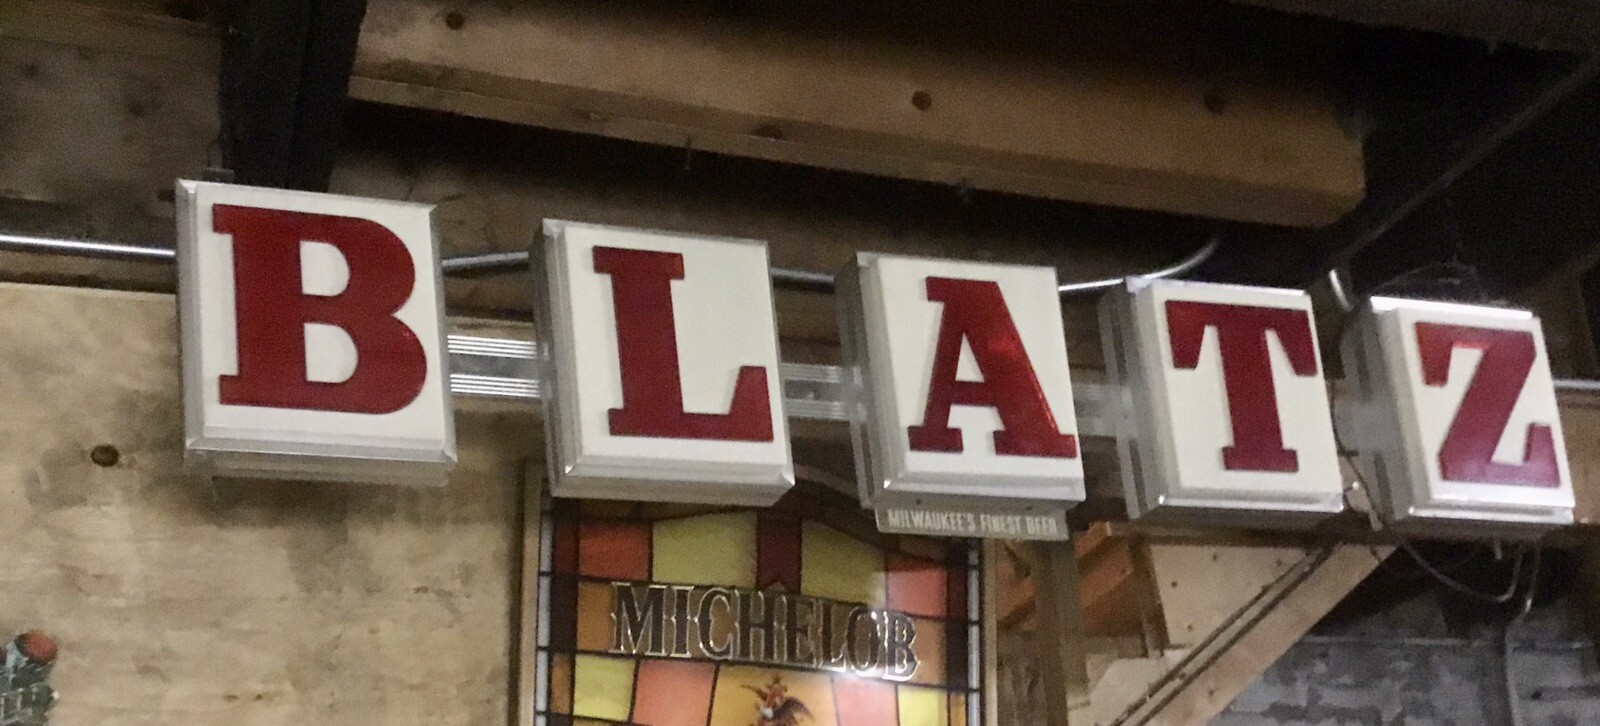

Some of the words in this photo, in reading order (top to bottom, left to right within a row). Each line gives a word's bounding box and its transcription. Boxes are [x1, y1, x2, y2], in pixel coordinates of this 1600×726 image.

[212, 203, 1560, 487] BLATZ
[888, 509, 975, 532] MILWAUKEE'S
[979, 513, 1022, 535] FINEST
[1025, 516, 1058, 536] BEER
[609, 581, 922, 682] MICHELOB
